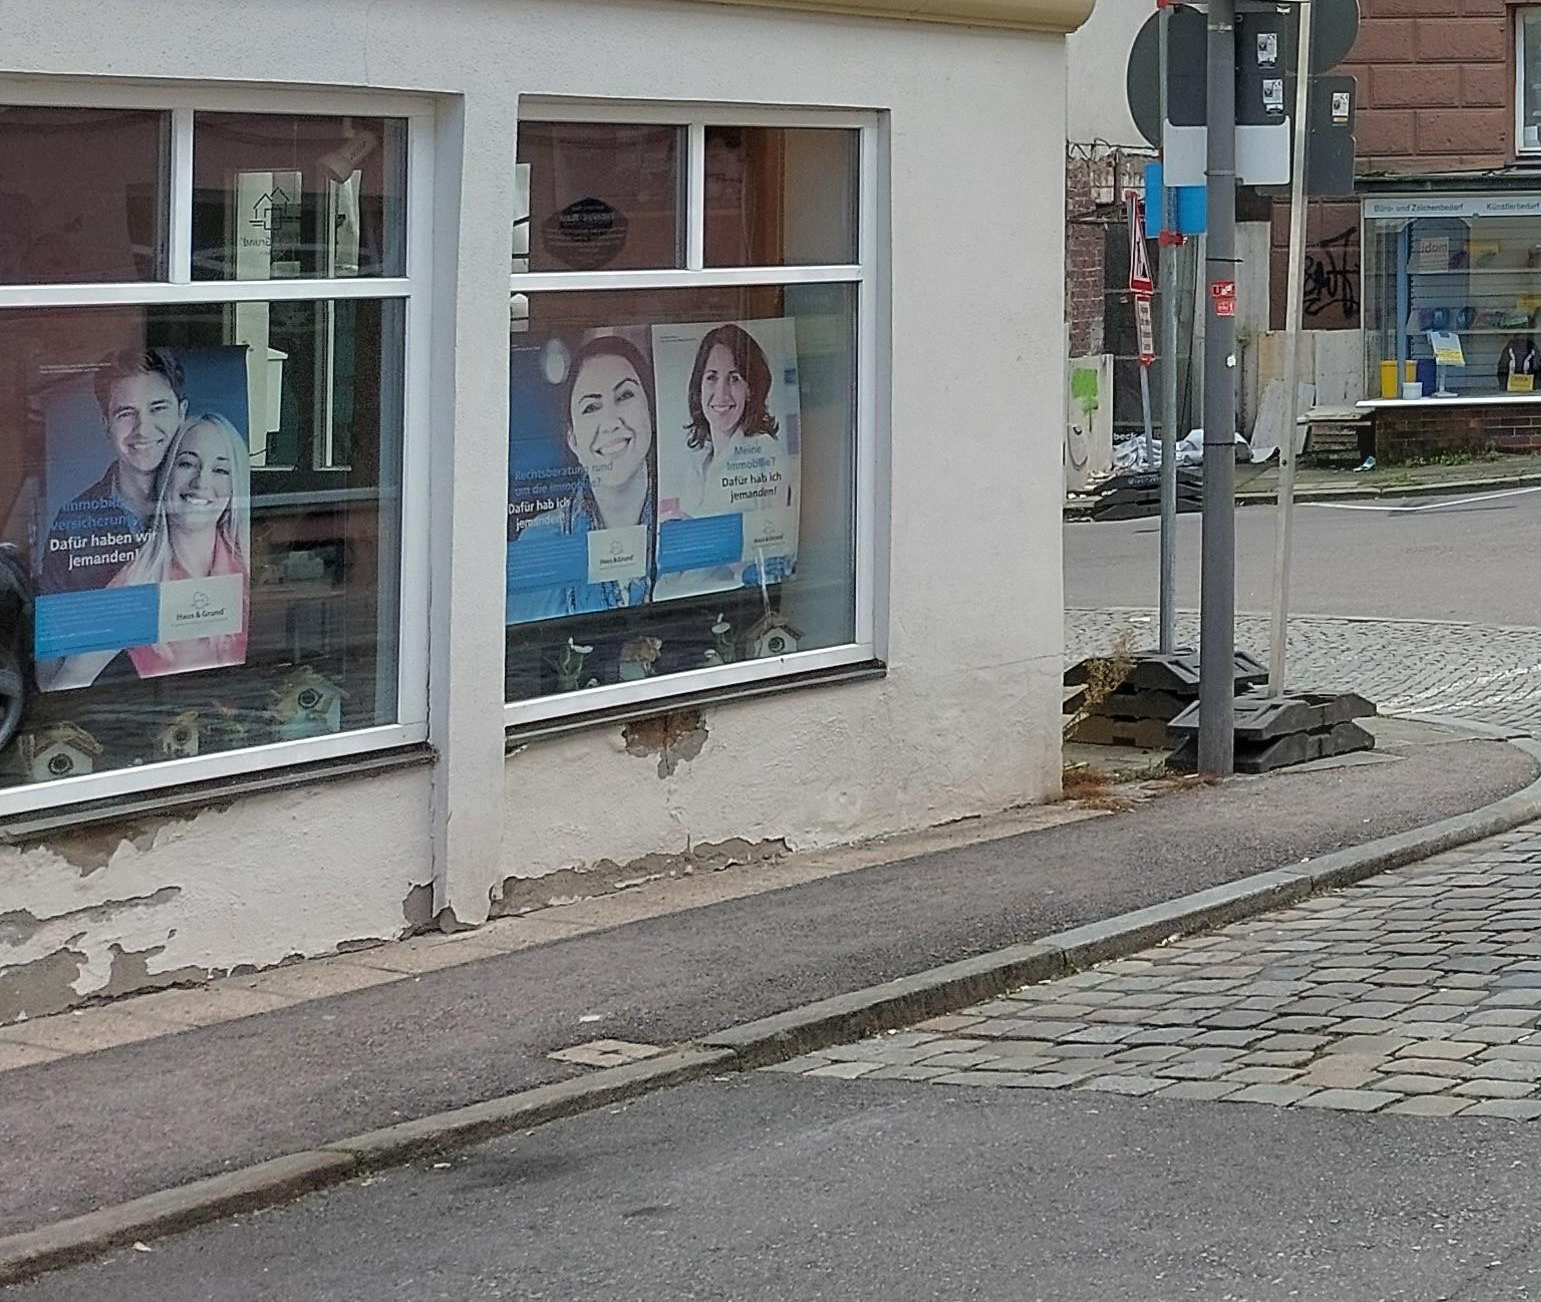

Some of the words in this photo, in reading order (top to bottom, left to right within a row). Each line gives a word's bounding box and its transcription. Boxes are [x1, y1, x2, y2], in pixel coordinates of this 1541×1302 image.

[1373, 203, 1395, 213] Büro-
[1396, 204, 1410, 213] und
[1411, 202, 1464, 212] Zeichenbedarf
[1486, 201, 1541, 211] Künstlerbedarf
[734, 445, 762, 455] Meine
[721, 477, 748, 488] Dafür
[750, 474, 768, 484] hab
[769, 472, 782, 482] ich
[532, 482, 548, 494] die
[730, 487, 778, 504] jemanden!
[508, 501, 534, 515] Dafür
[536, 499, 555, 512] hab
[556, 497, 571, 508] ich
[50, 536, 88, 552] Dafür
[91, 533, 132, 547] haben
[68, 549, 139, 570] jemanden!
[176, 612, 195, 621] Haus
[195, 611, 201, 619] &
[202, 608, 225, 618] Grund
